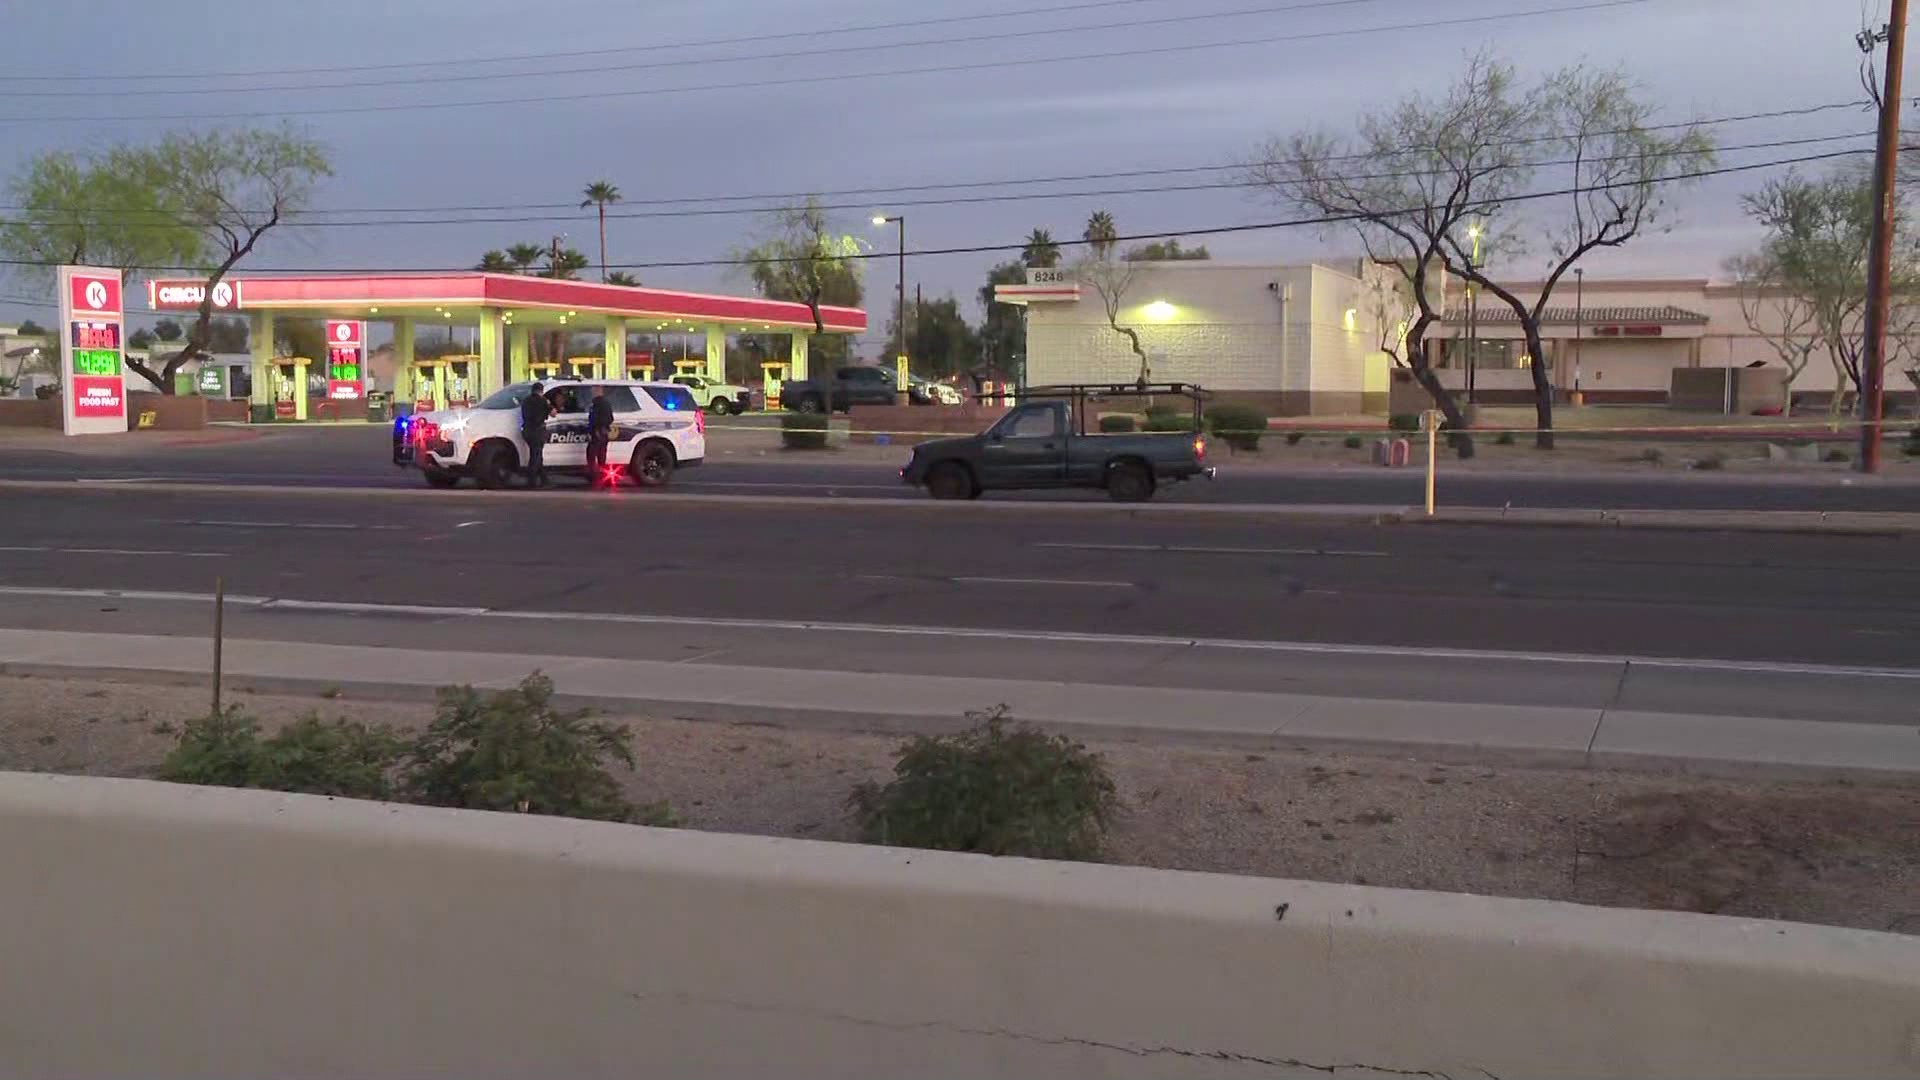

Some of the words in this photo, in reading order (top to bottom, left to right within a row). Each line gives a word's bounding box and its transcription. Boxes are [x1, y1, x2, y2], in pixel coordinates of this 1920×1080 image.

[90, 285, 105, 306] K
[79, 397, 101, 407] FOOD
[101, 397, 120, 407] FAST
[550, 431, 588, 443] Police
